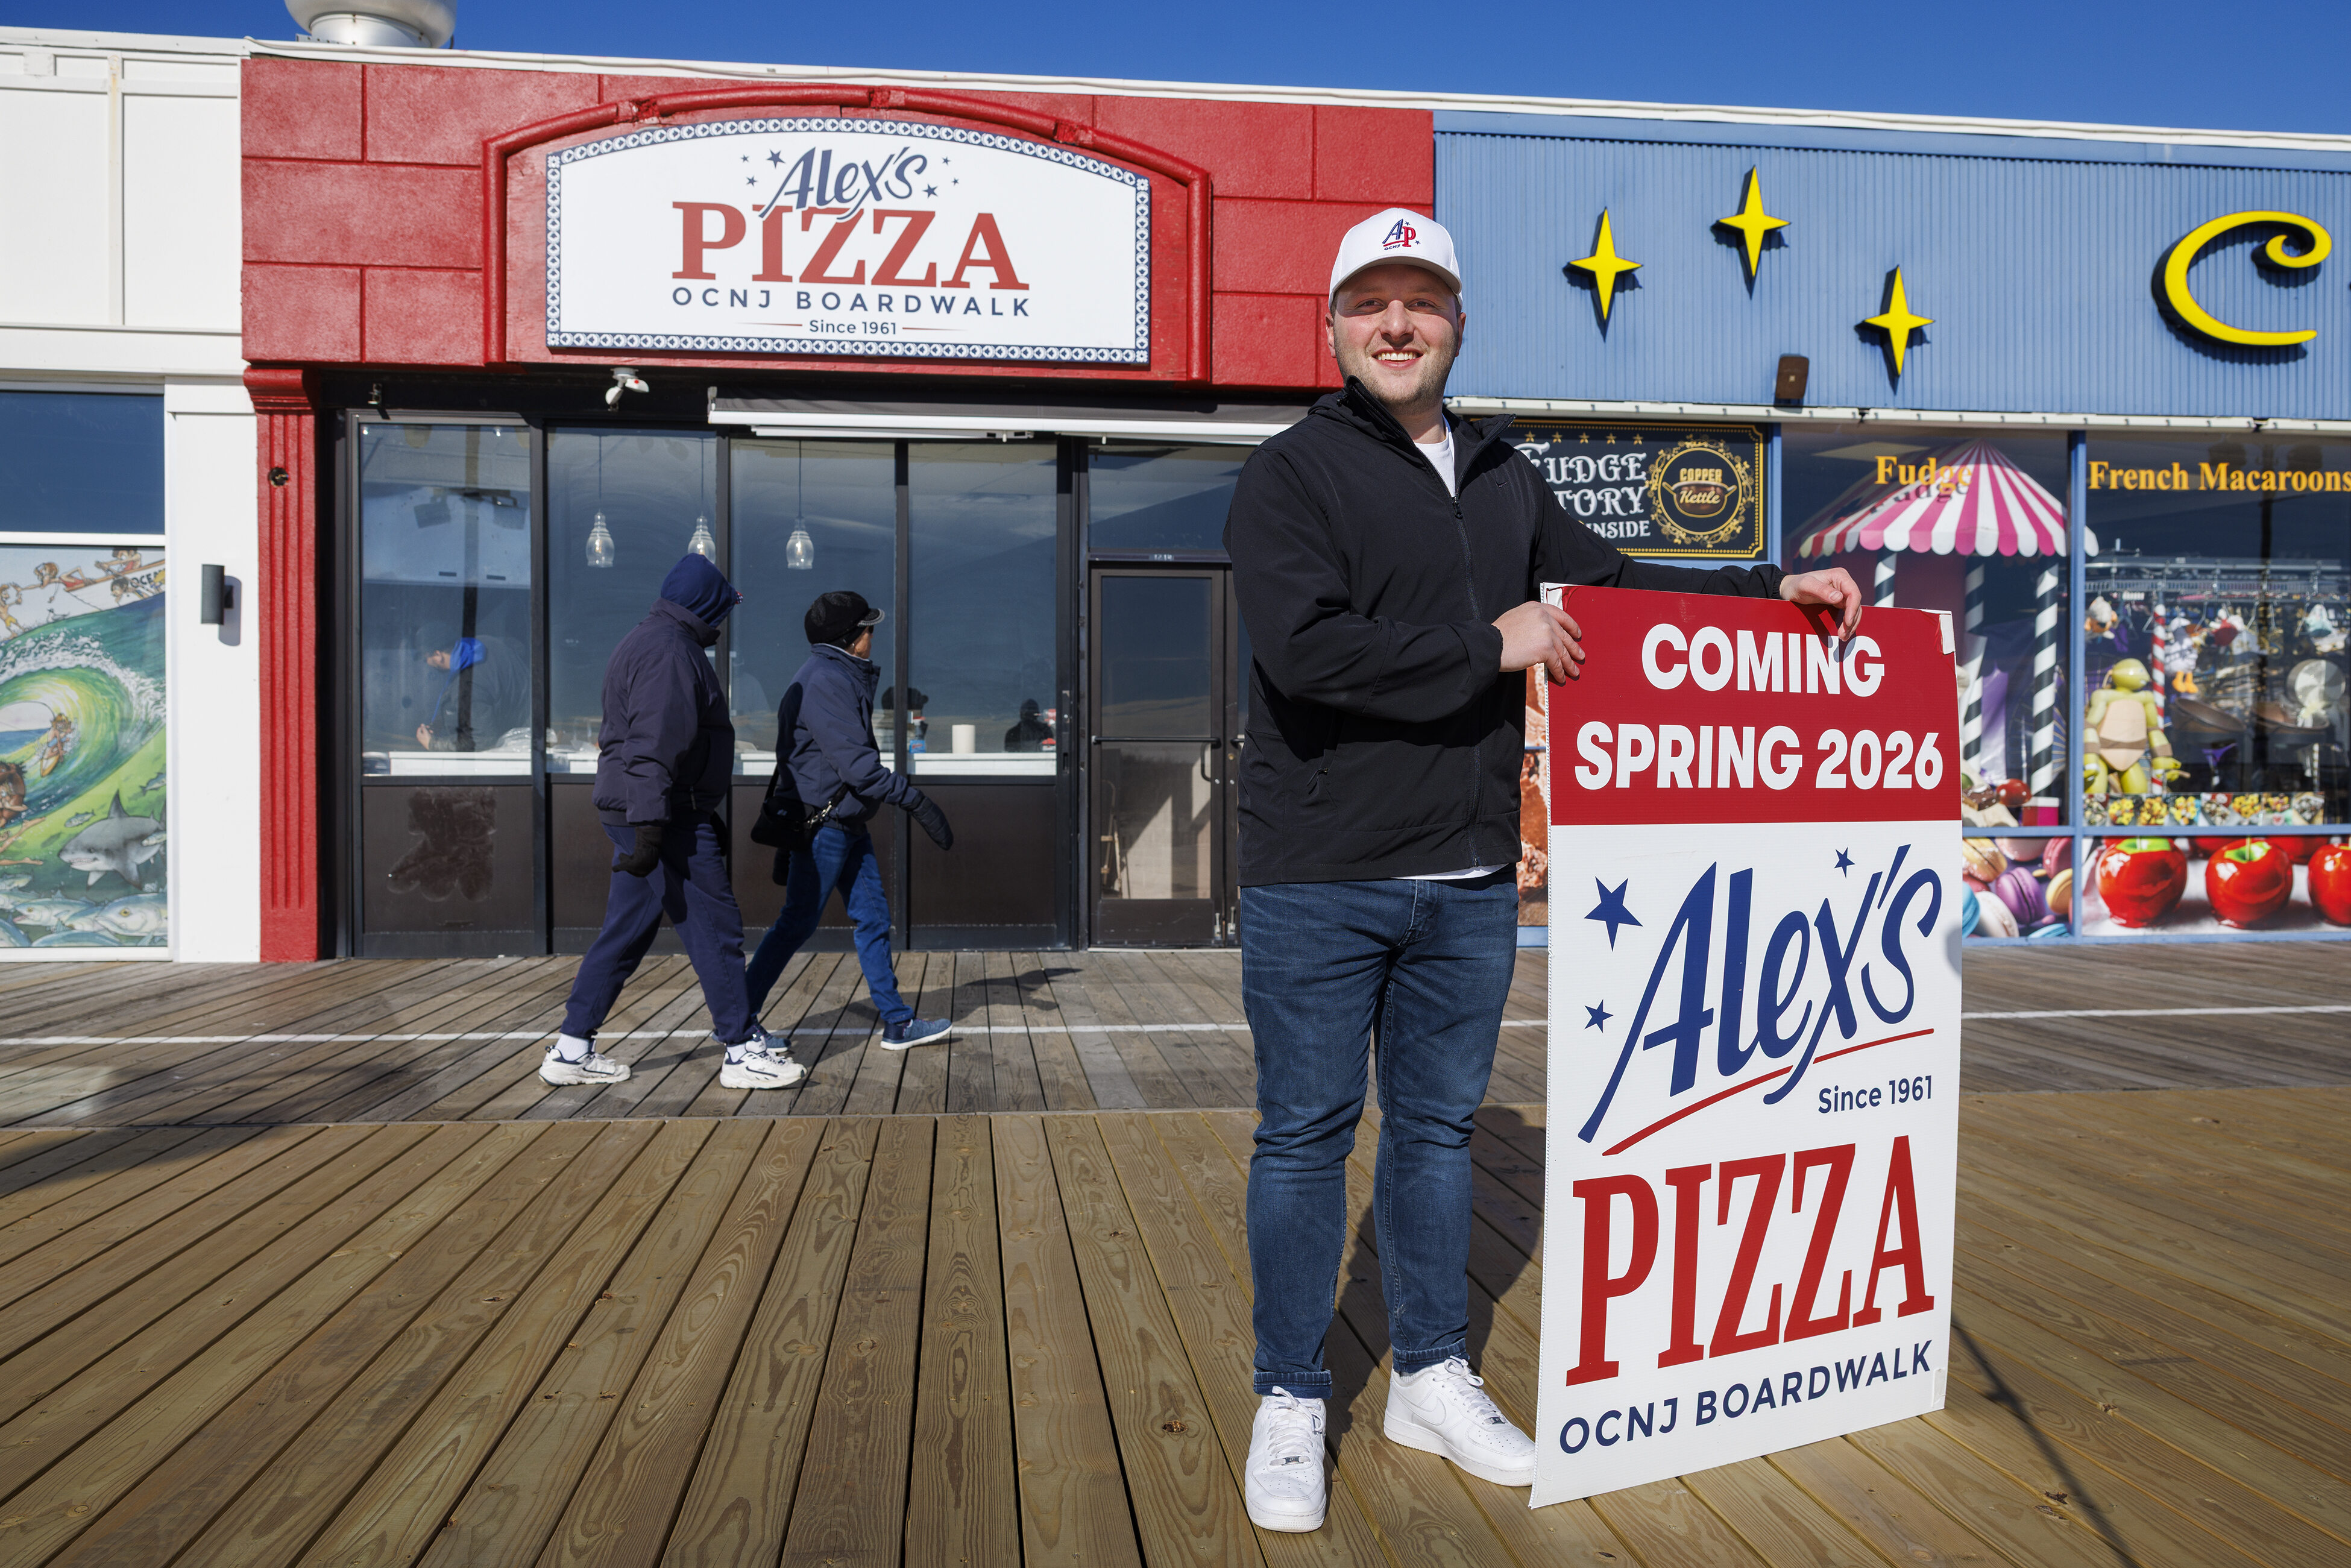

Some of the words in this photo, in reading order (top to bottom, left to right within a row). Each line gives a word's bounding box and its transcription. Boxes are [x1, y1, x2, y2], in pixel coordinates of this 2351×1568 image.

[758, 146, 927, 219] Alex's
[672, 201, 1030, 291] PIZZA
[672, 287, 770, 308] OCNJ
[796, 291, 1029, 316] BOARDWALK
[809, 320, 857, 334] Since
[862, 321, 897, 335] 1961
[1680, 468, 1722, 482] COPPER
[1875, 455, 1972, 493] Fudge
[2088, 461, 2189, 491] French
[2198, 462, 2351, 492] Macaroons
[1553, 486, 1649, 517] TORY
[1679, 490, 1721, 504] Kettle
[130, 568, 165, 588] OCE
[1641, 623, 1885, 697] COMING
[1575, 721, 1803, 790] SPRING
[1815, 728, 1943, 790] 2026
[1578, 844, 1942, 1144] Alex's
[1818, 1085, 1881, 1114] Since
[1889, 1075, 1933, 1104] 1961
[1566, 1135, 1934, 1387] PIZZA
[1559, 1397, 1678, 1454] OCNJ
[1695, 1340, 1932, 1426] BOARDWALK
